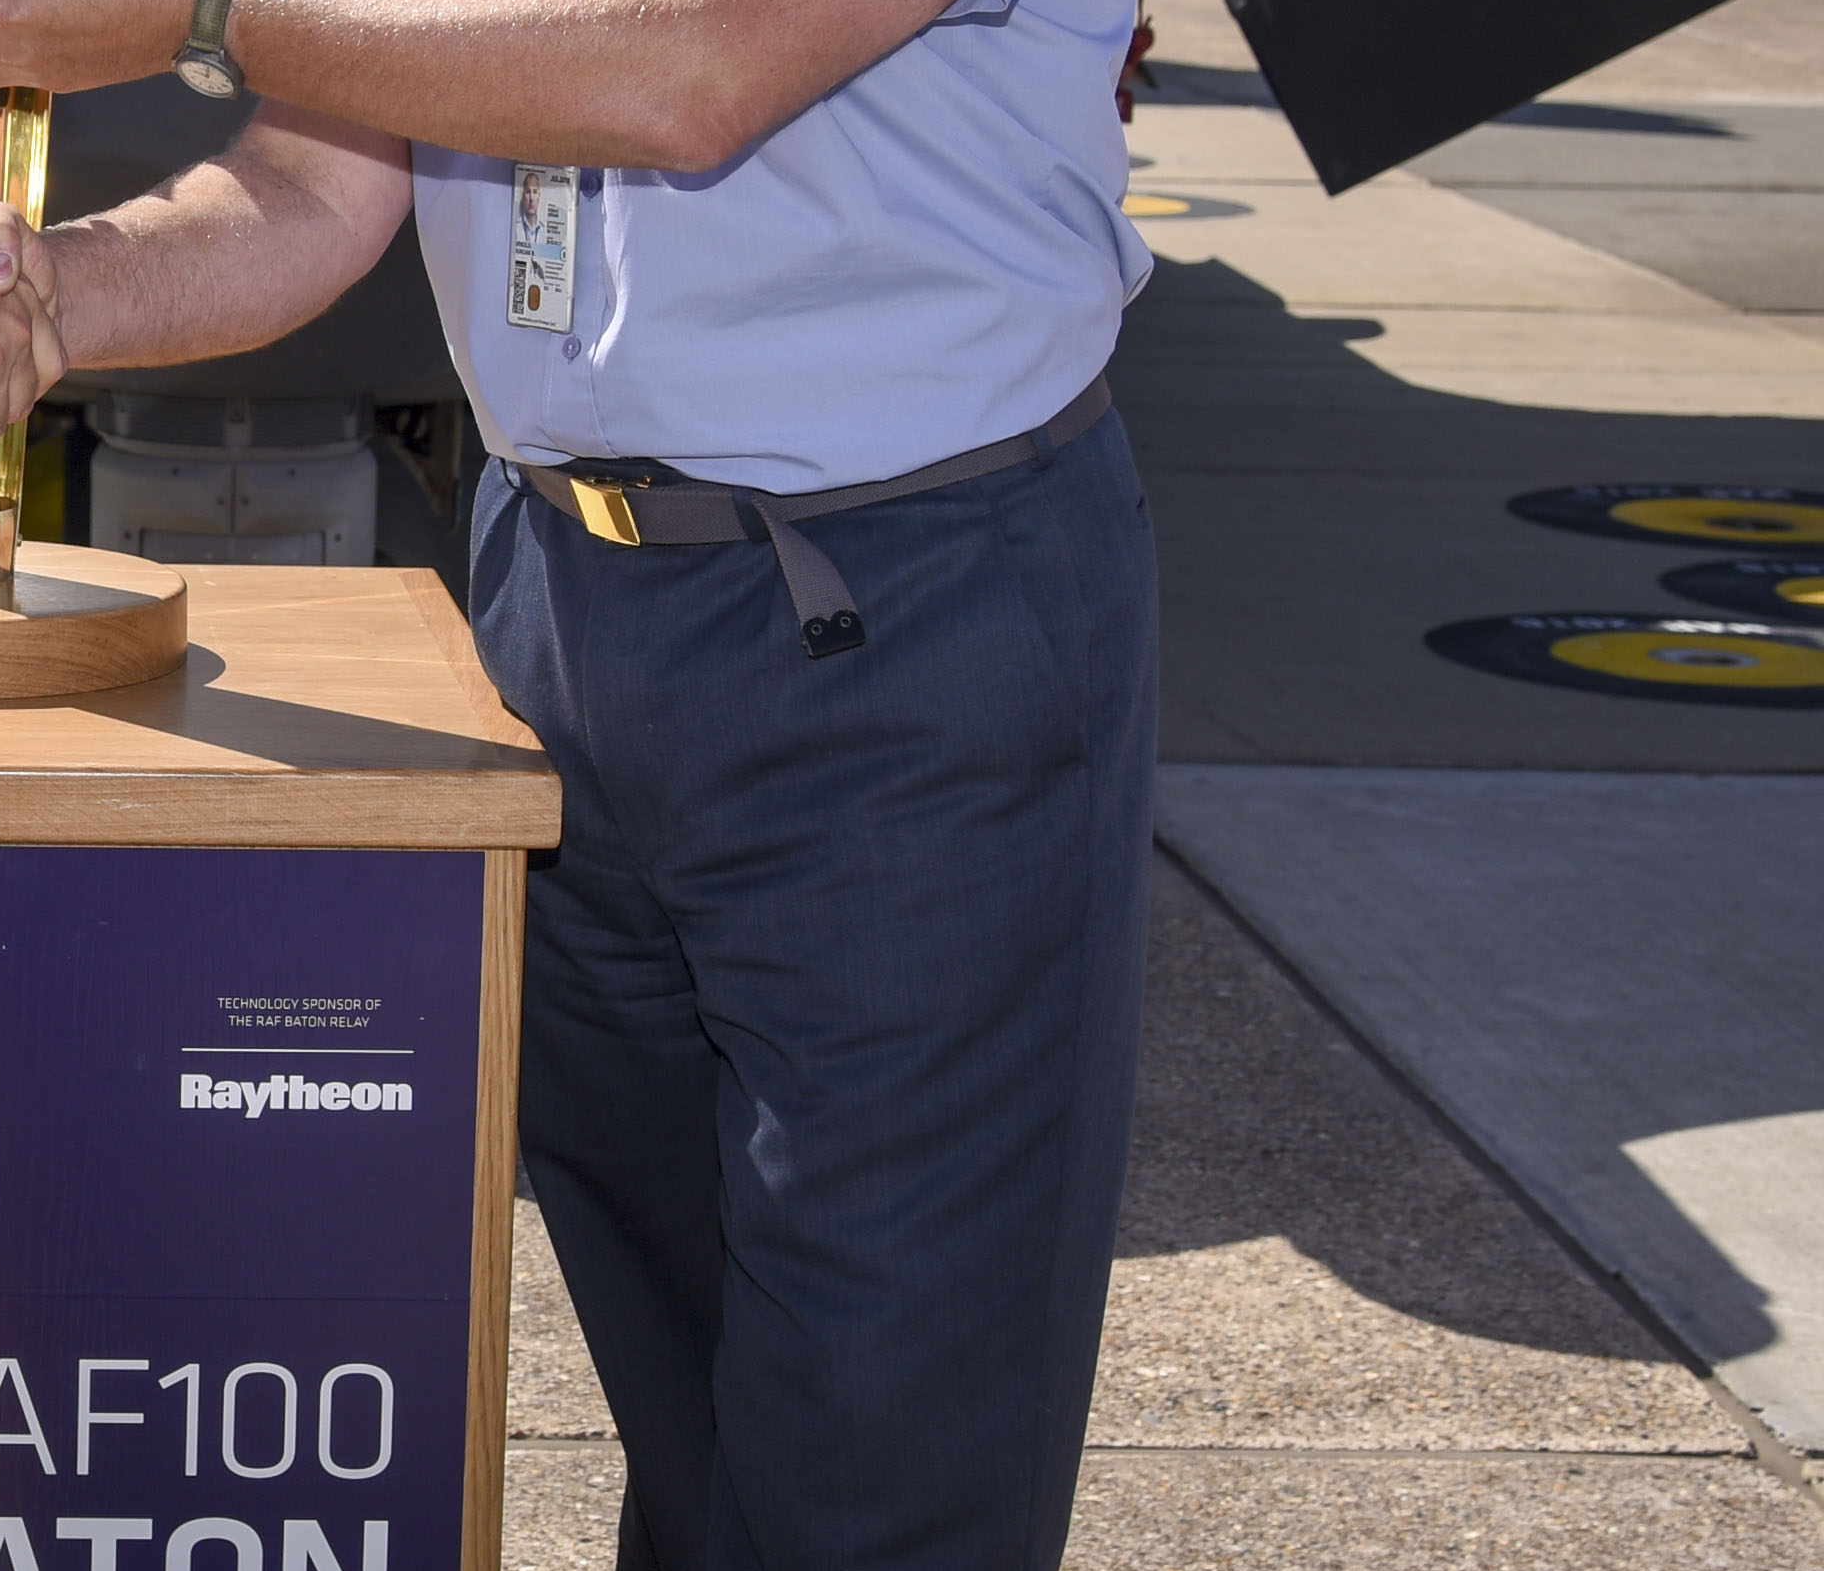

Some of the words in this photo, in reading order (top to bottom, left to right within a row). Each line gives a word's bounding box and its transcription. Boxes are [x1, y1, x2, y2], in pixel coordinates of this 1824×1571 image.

[217, 997, 299, 1010] TECHNOLOGY
[302, 998, 362, 1011] SPONSOR
[365, 999, 382, 1011] OF
[229, 1015, 253, 1027] THE
[256, 1015, 282, 1028] RAF
[284, 1015, 327, 1028] BATON
[329, 1016, 370, 1028] RELAY
[180, 1073, 413, 1119] Raytheon
